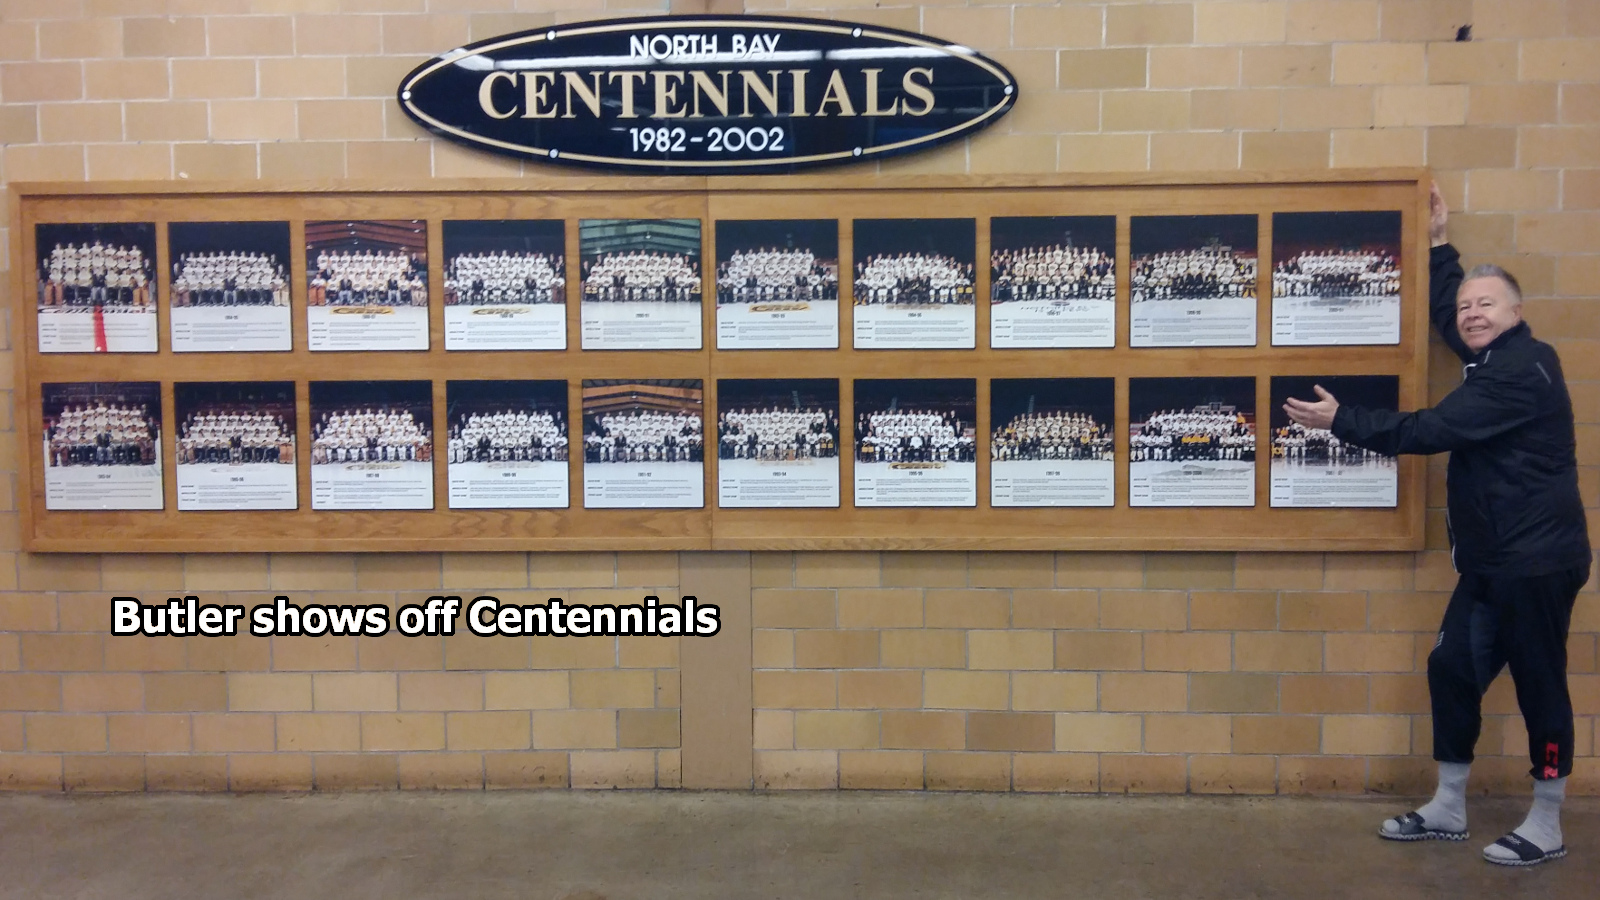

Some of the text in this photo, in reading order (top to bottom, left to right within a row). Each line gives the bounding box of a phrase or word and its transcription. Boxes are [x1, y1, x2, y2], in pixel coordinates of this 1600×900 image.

[629, 34, 780, 59] NORTH BAY
[478, 68, 935, 119] CENTENNIALS
